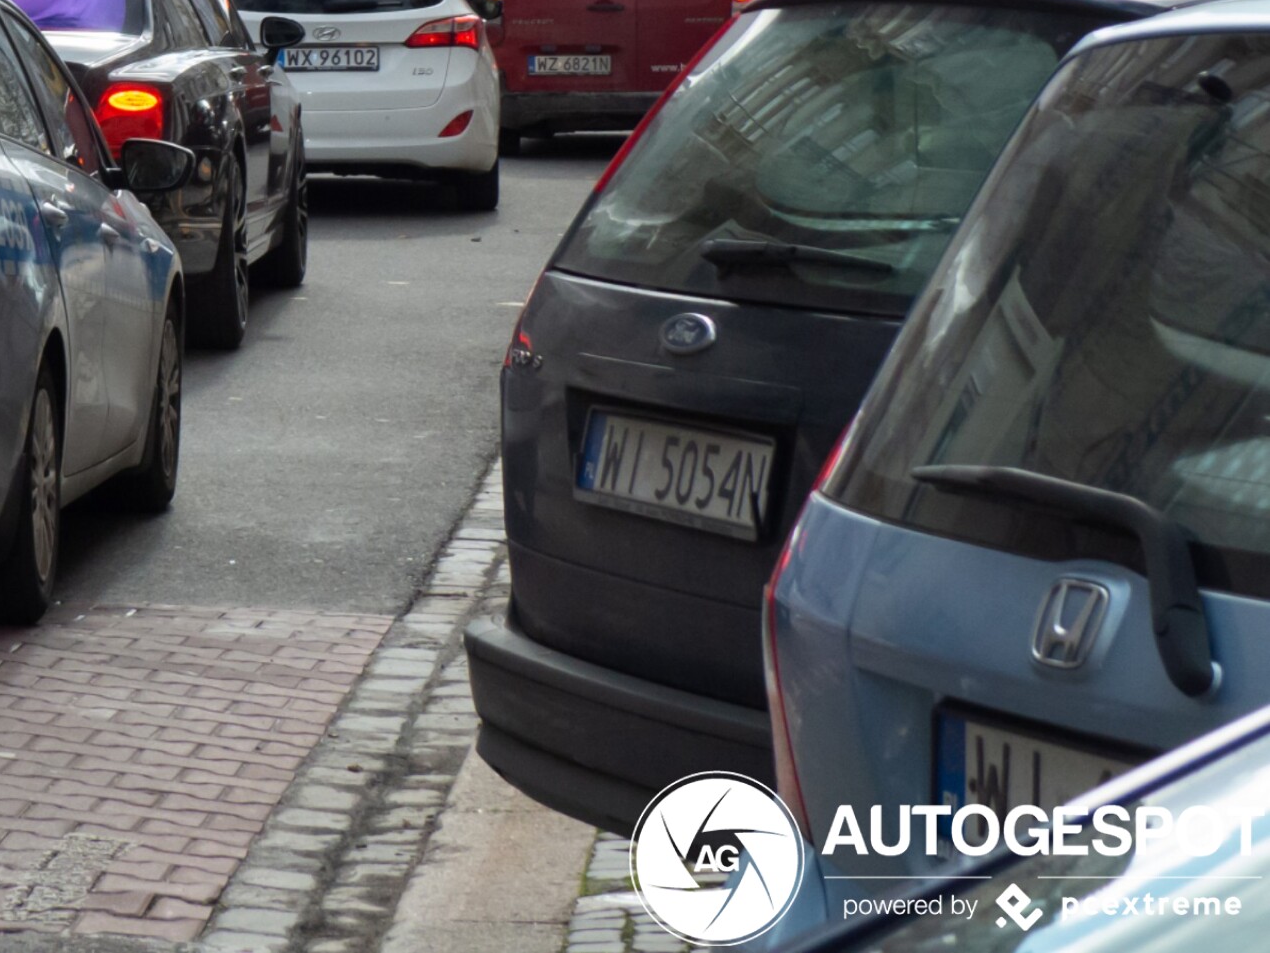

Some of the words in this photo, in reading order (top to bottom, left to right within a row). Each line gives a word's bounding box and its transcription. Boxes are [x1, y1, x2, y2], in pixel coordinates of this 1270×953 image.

[287, 49, 313, 66] WX
[320, 49, 376, 66] 96102
[537, 57, 559, 72] WZ
[564, 57, 610, 72] 6821N
[601, 424, 645, 495] WI
[654, 435, 767, 519] 5054N
